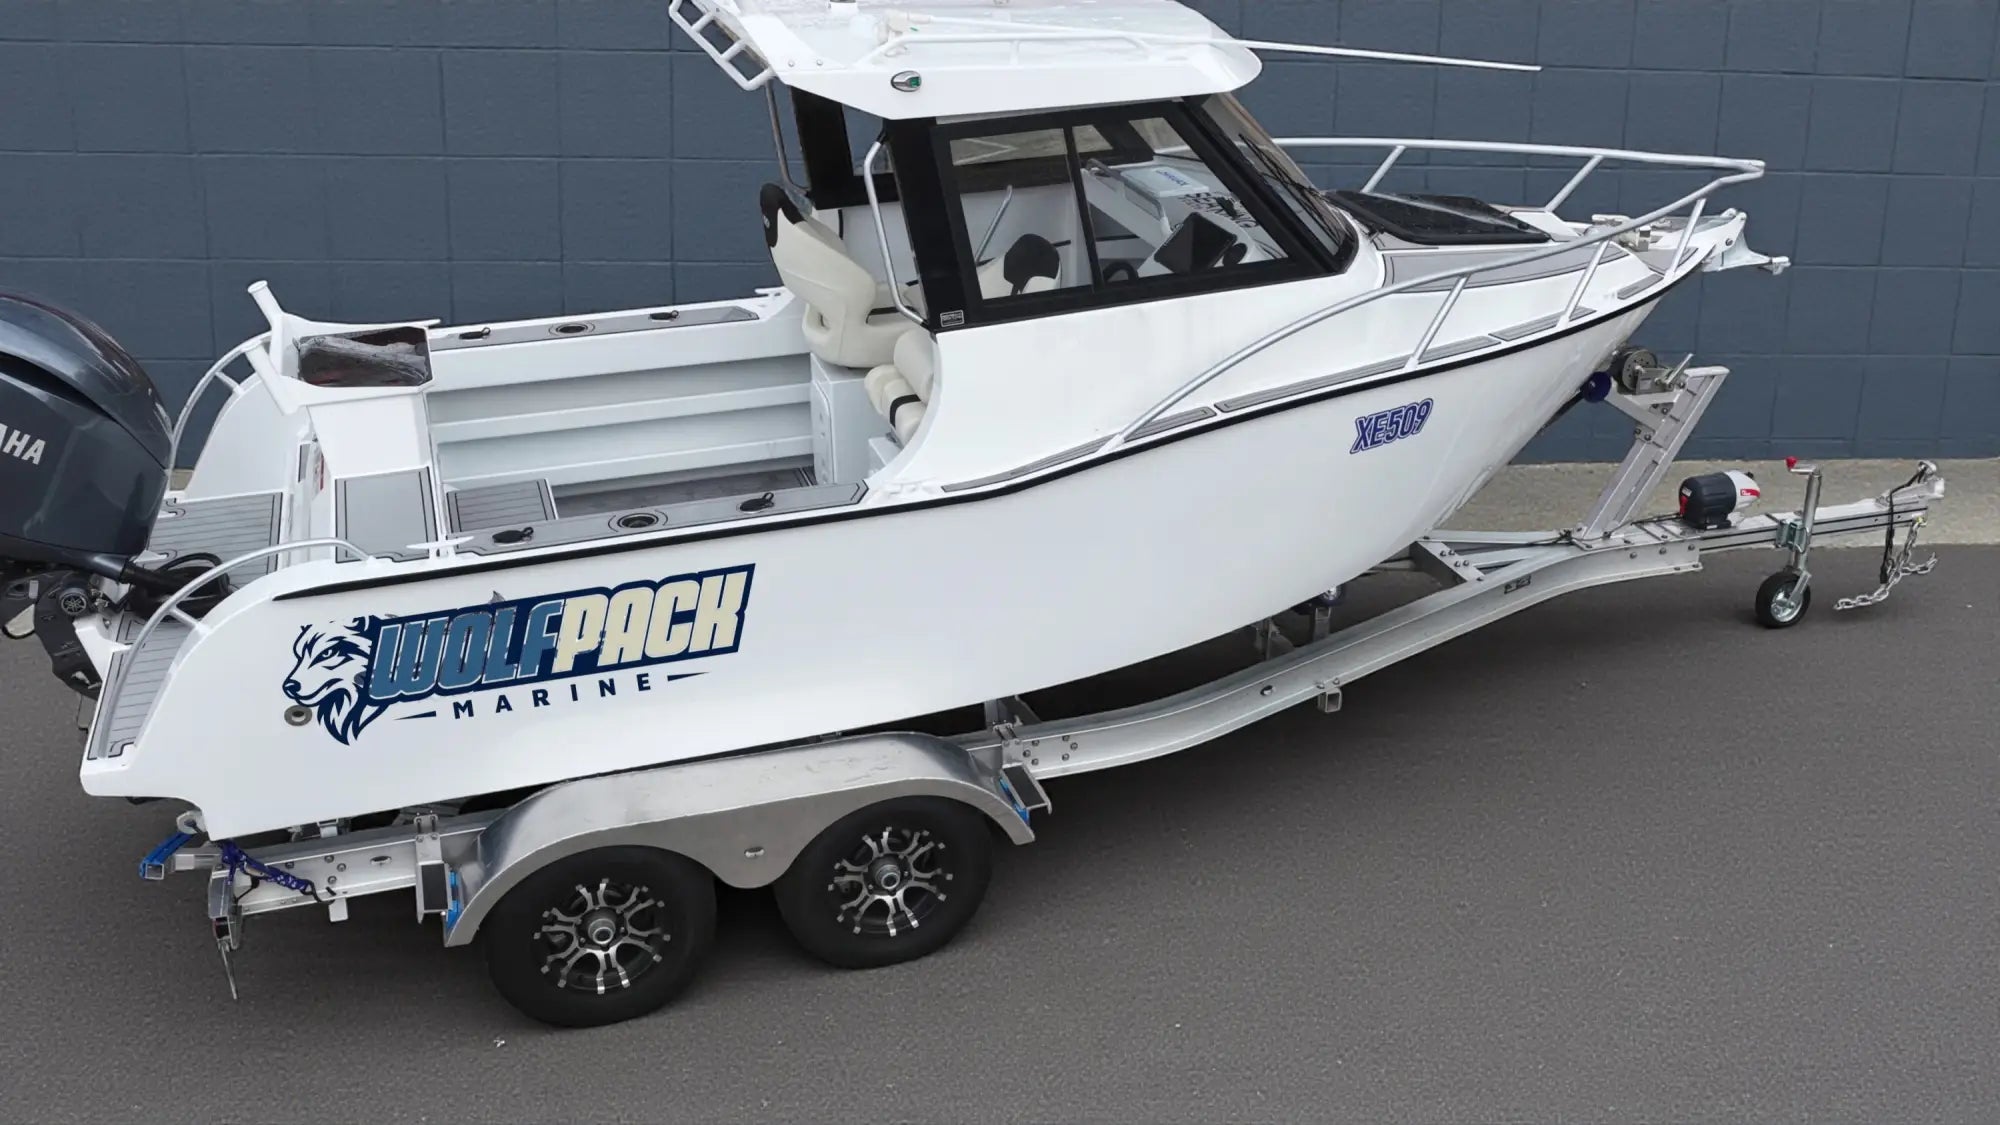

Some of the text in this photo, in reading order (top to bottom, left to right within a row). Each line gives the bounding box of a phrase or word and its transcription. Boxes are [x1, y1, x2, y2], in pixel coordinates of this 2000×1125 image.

[1350, 398, 1434, 454] XE509
[368, 564, 756, 706] WOLFPACK
[452, 673, 652, 719] MARINE
